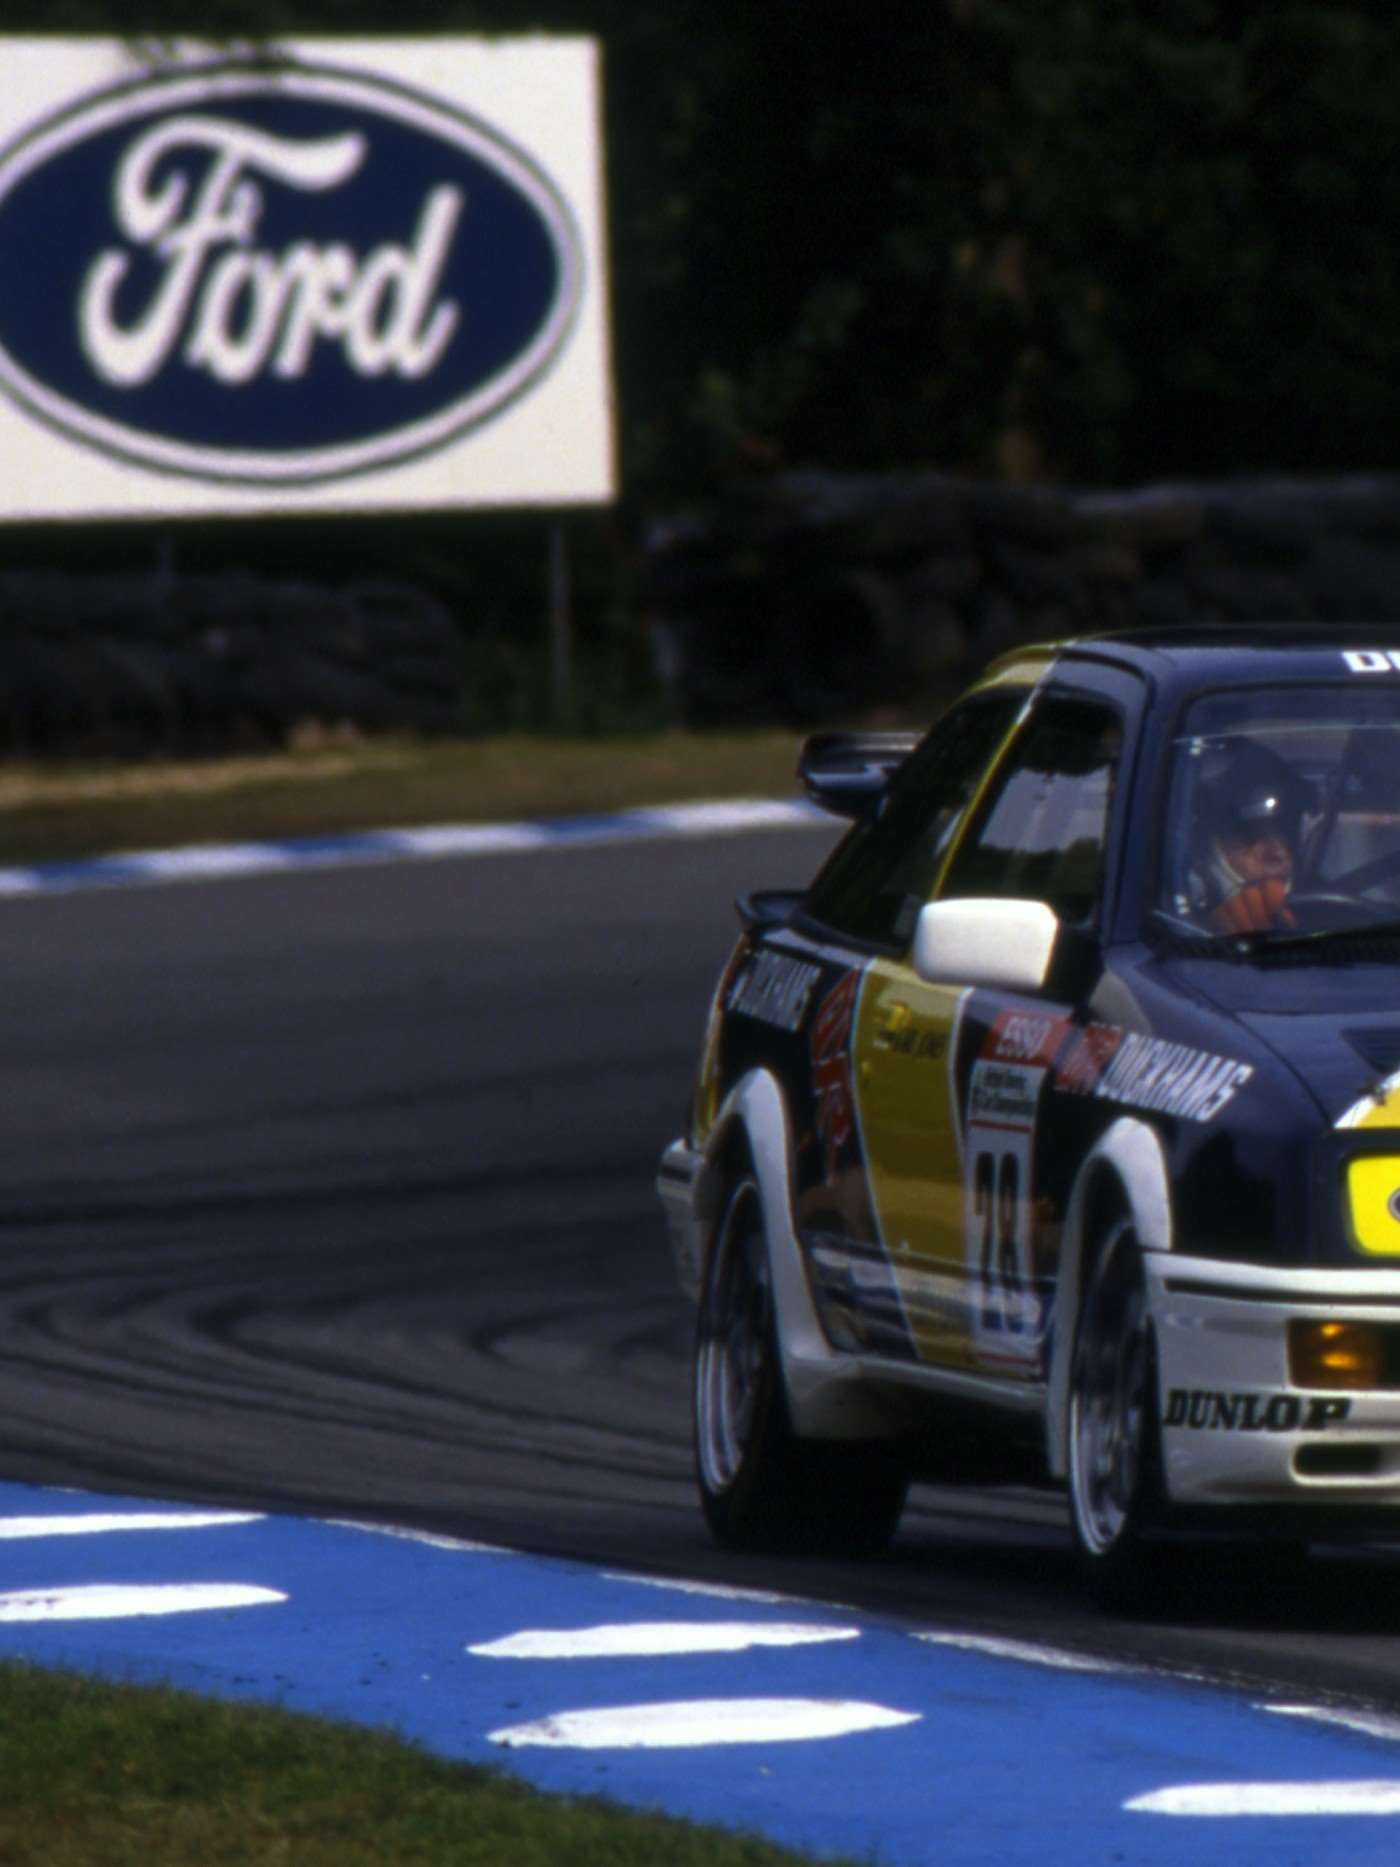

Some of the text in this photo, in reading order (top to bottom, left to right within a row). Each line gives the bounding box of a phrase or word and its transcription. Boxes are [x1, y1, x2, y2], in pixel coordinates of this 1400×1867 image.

[79, 113, 463, 385] Ford
[1095, 1031, 1253, 1122] DUCKHAMS
[1165, 1388, 1351, 1433] DUNLOP
